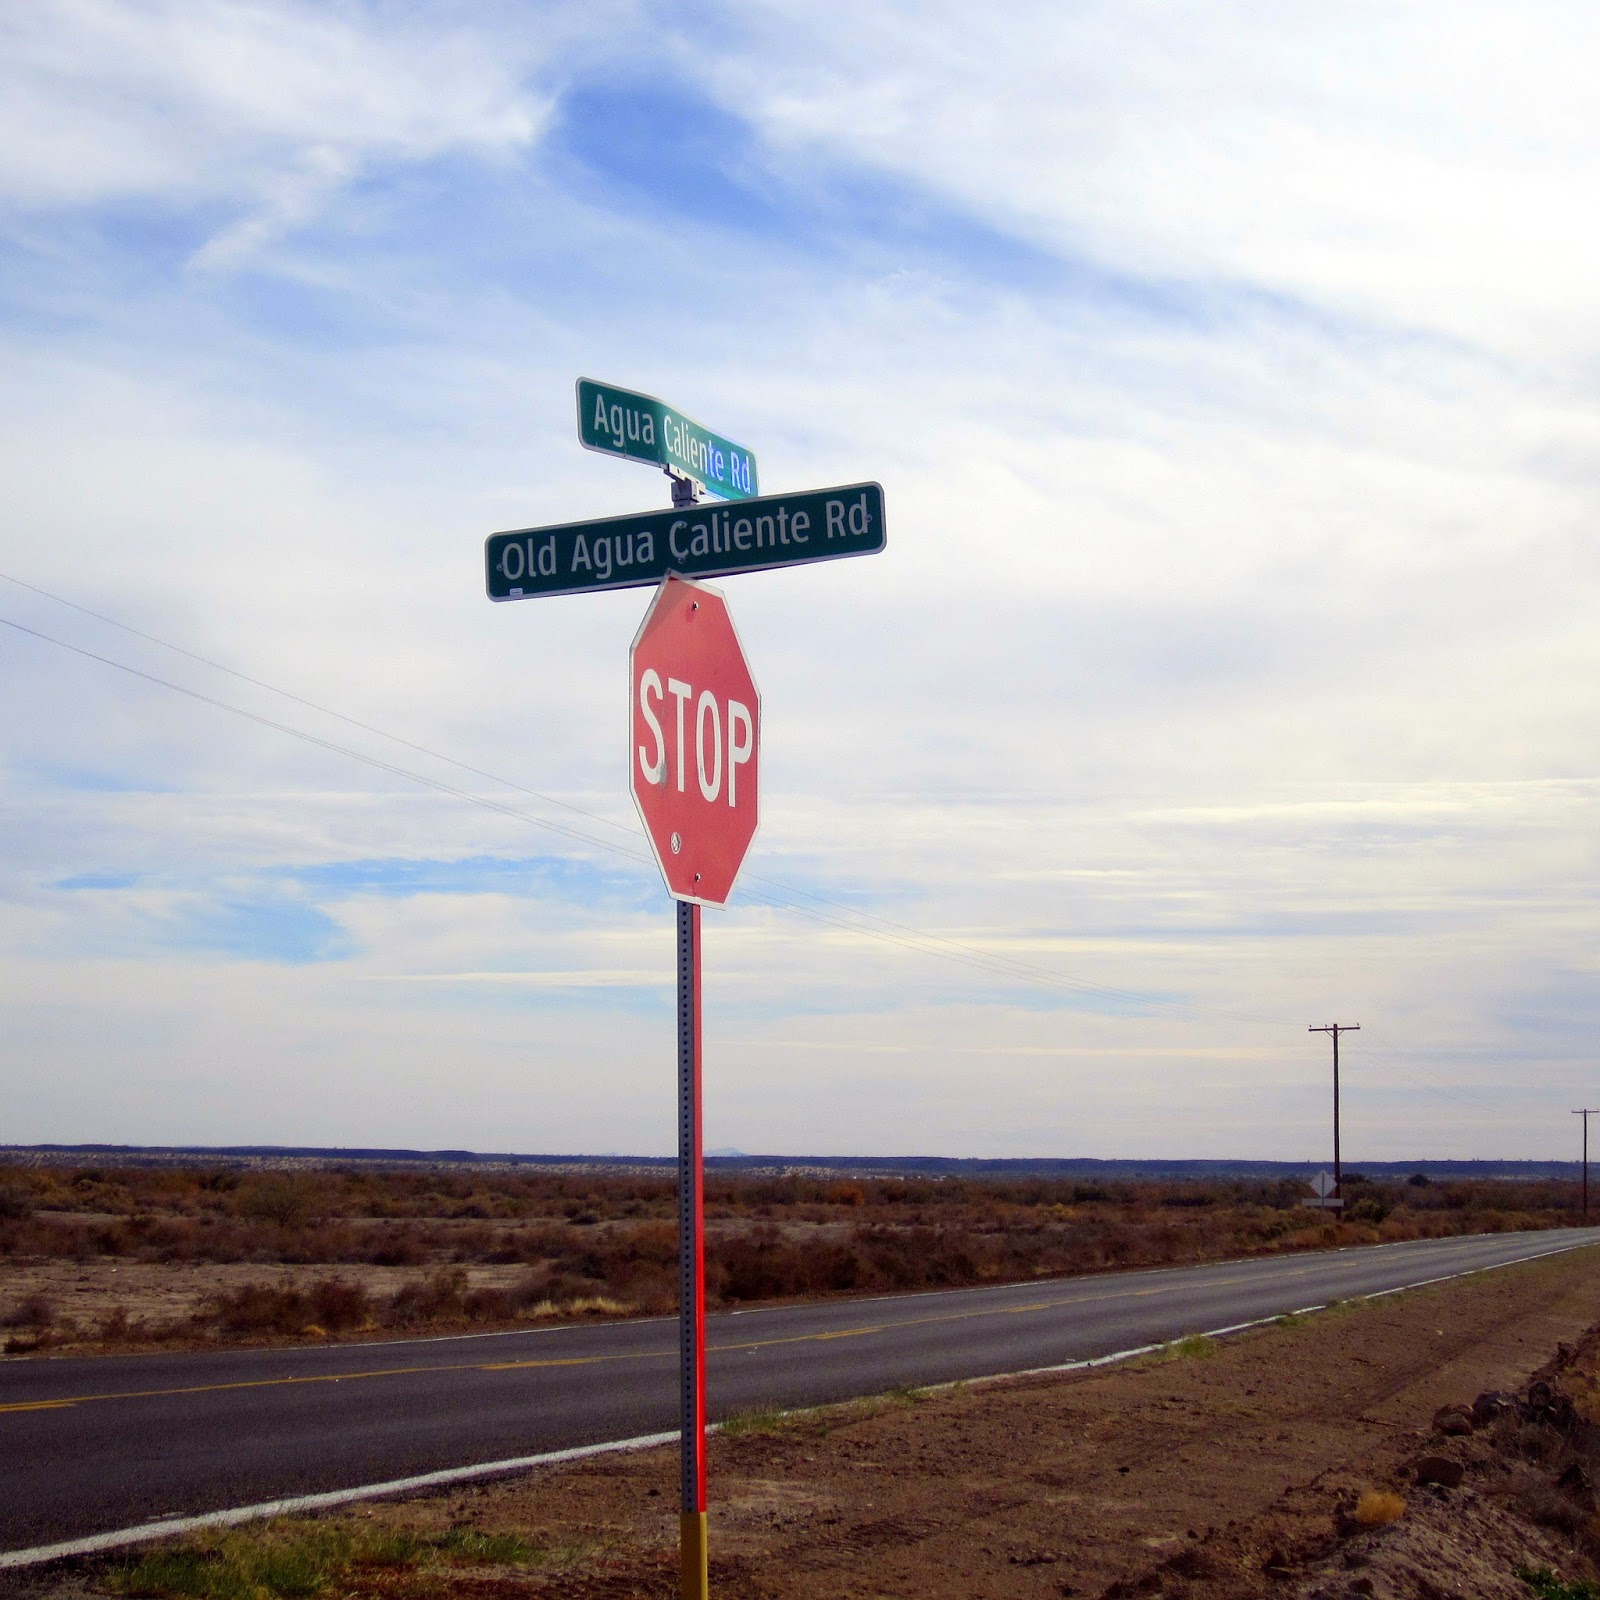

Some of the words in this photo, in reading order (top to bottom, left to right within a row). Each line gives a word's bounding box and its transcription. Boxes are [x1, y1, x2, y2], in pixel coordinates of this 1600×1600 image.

[594, 394, 655, 448] Agua
[663, 415, 725, 481] Caliente
[730, 451, 751, 494] Rd
[502, 536, 557, 580] Old
[571, 530, 655, 579] Agua
[669, 506, 811, 559] Caliente
[826, 493, 869, 539] Rd
[639, 668, 753, 808] STOP
